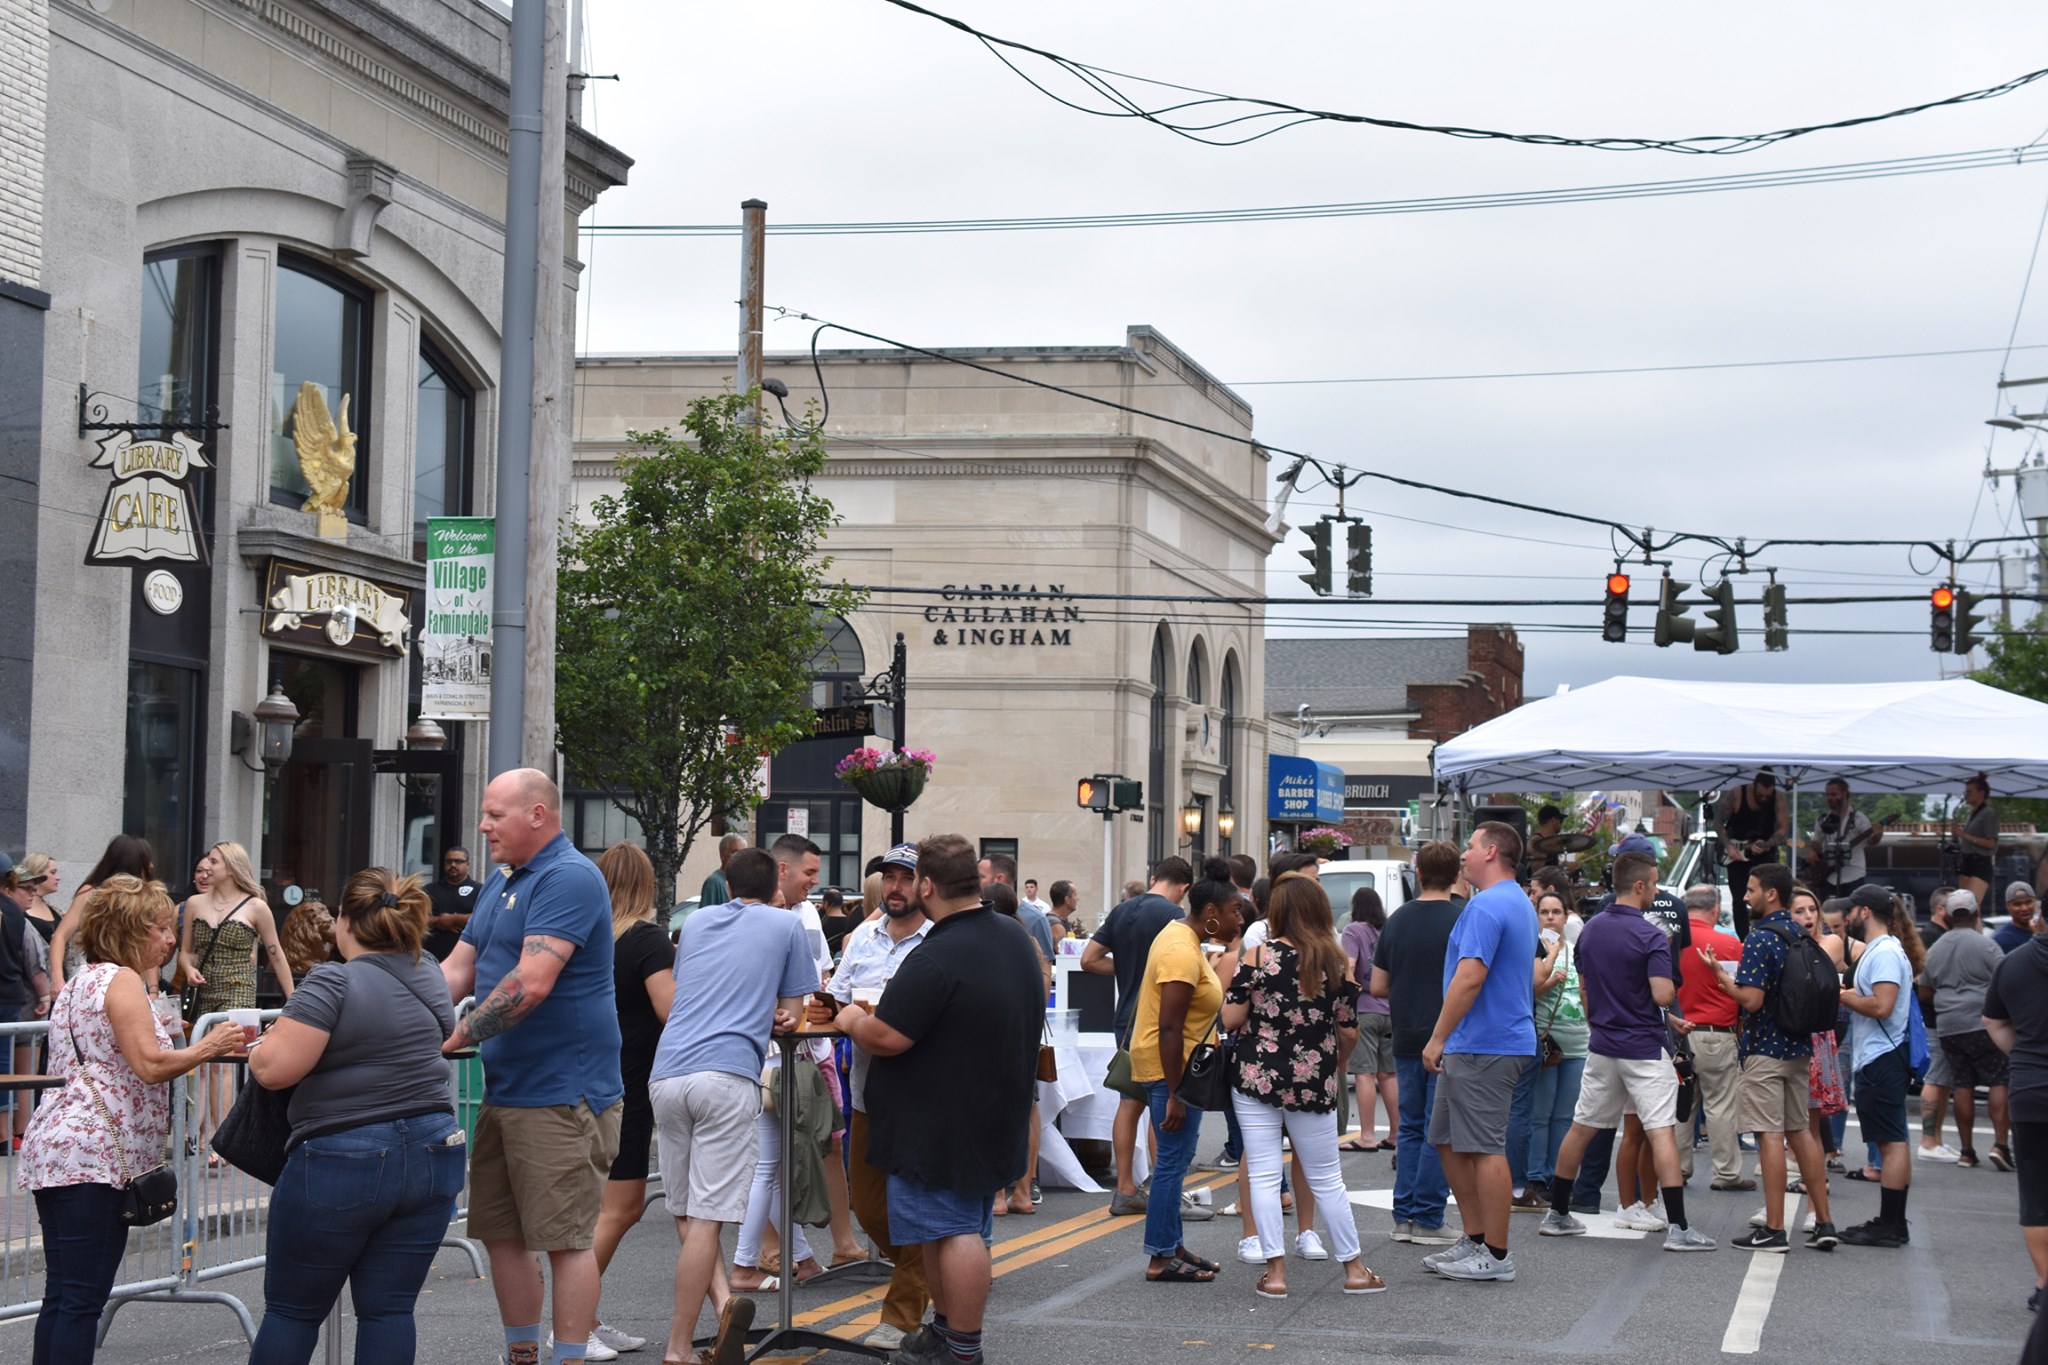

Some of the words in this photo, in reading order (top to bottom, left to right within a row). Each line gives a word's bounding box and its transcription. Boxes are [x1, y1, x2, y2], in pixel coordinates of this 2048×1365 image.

[120, 445, 184, 475] LIBRARY
[111, 491, 180, 535] CAFE
[433, 528, 488, 542] Welcome
[443, 544, 455, 555] to
[459, 542, 479, 555] the
[433, 561, 487, 593] Village
[152, 582, 178, 602] FOOD
[306, 575, 387, 625] LIBRARY
[454, 594, 464, 608] of
[428, 609, 489, 638] Farmingdale
[933, 628, 949, 646] &
[957, 628, 1073, 646] INGHAM
[1279, 774, 1314, 787] Mike's
[1278, 788, 1315, 798] BARBER
[1344, 784, 1390, 799] BRUNCH
[1284, 799, 1309, 810] SHOP
[791, 819, 804, 827] BUS
[1388, 873, 1398, 881] 15
